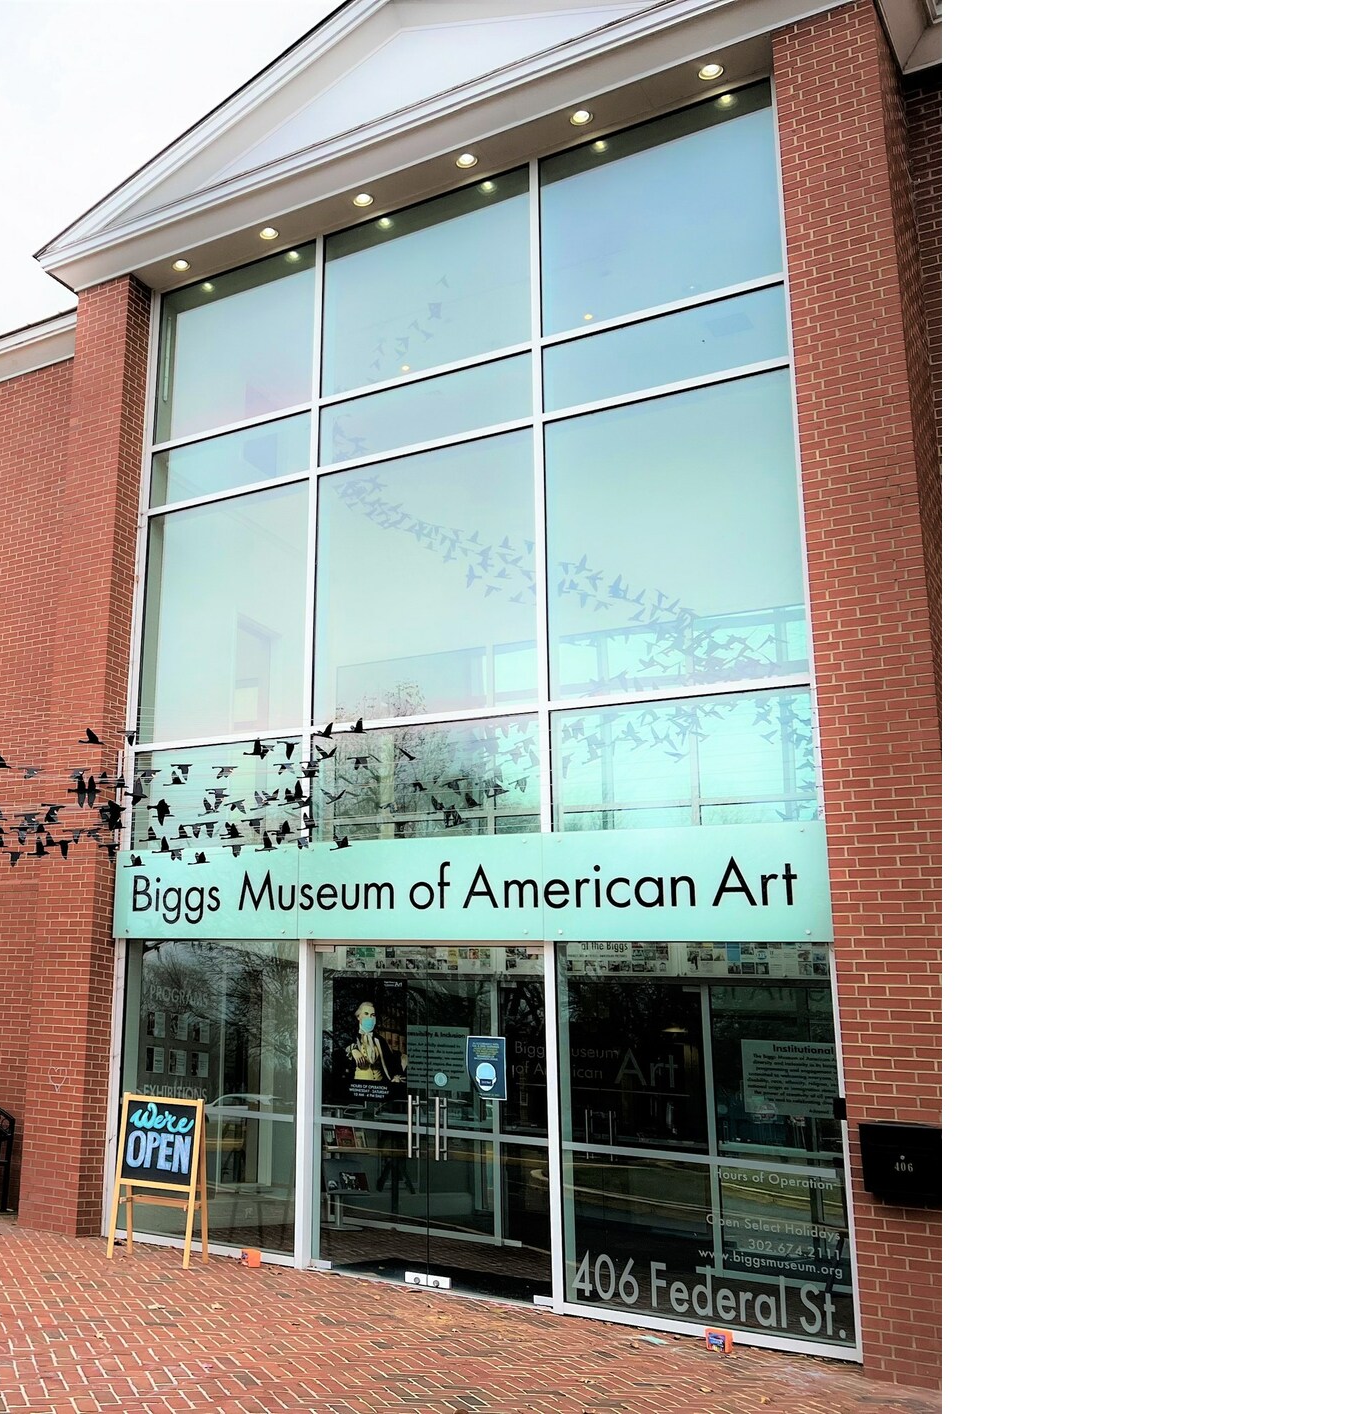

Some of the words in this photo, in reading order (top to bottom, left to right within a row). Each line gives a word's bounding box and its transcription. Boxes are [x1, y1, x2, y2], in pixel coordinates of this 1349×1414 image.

[131, 874, 221, 925] Biggs
[238, 869, 395, 912] Museum
[409, 861, 451, 910] of
[462, 863, 697, 910] American
[711, 855, 798, 907] Art
[606, 942, 628, 953] Biggs
[150, 985, 208, 1007] PROGRAMS
[515, 1040, 546, 1059] Bigg
[570, 1047, 620, 1059] useum
[772, 1044, 834, 1055] Institutional
[515, 1060, 531, 1075] of
[614, 1048, 679, 1088] Art
[143, 1084, 207, 1101] EXHIBITIONS
[130, 1102, 194, 1133] We're
[125, 1130, 192, 1174] OPEN
[714, 1167, 748, 1182] Hours
[752, 1171, 765, 1183] of
[768, 1174, 834, 1191] Operation
[894, 1162, 914, 1173] 406
[706, 1214, 740, 1229] Open
[744, 1219, 781, 1234] Select
[785, 1224, 841, 1242] Holidays
[748, 1239, 841, 1261] 302.674.2111
[698, 1249, 844, 1279] www.biggsmuseum.org
[571, 1249, 640, 1305] 406
[650, 1261, 789, 1329] Federal
[800, 1283, 847, 1339] St.
